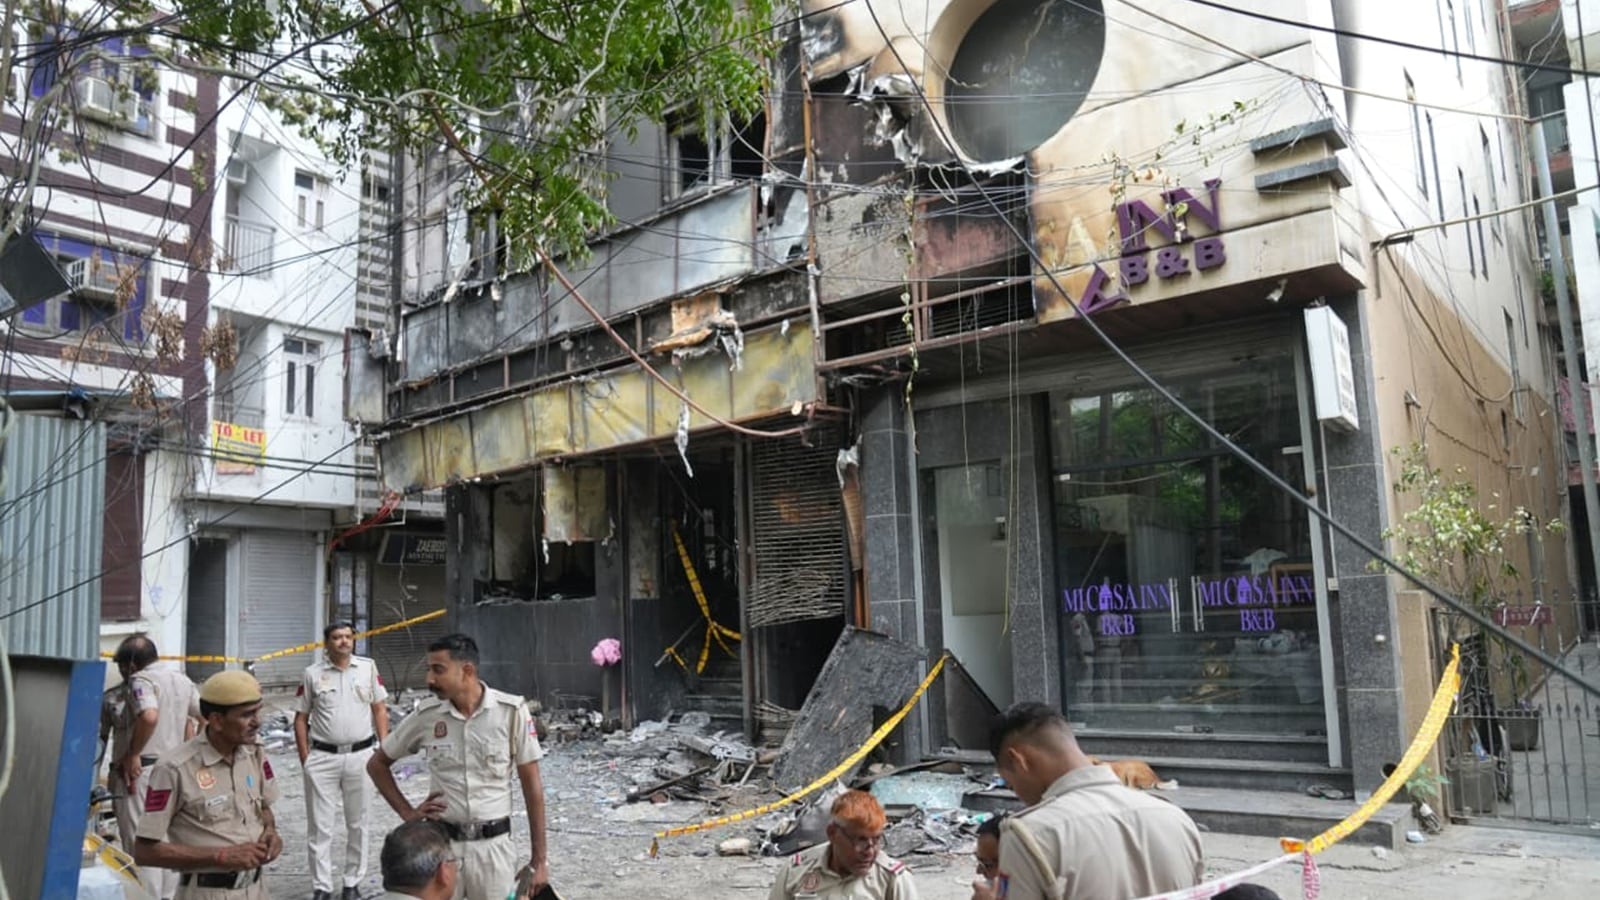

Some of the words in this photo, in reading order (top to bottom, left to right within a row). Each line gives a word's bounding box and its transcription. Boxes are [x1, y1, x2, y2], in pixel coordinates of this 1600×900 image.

[216, 424, 232, 437] TO
[244, 430, 264, 443] LET
[1101, 614, 1135, 635] B&B
[1240, 608, 1275, 631] B&B
